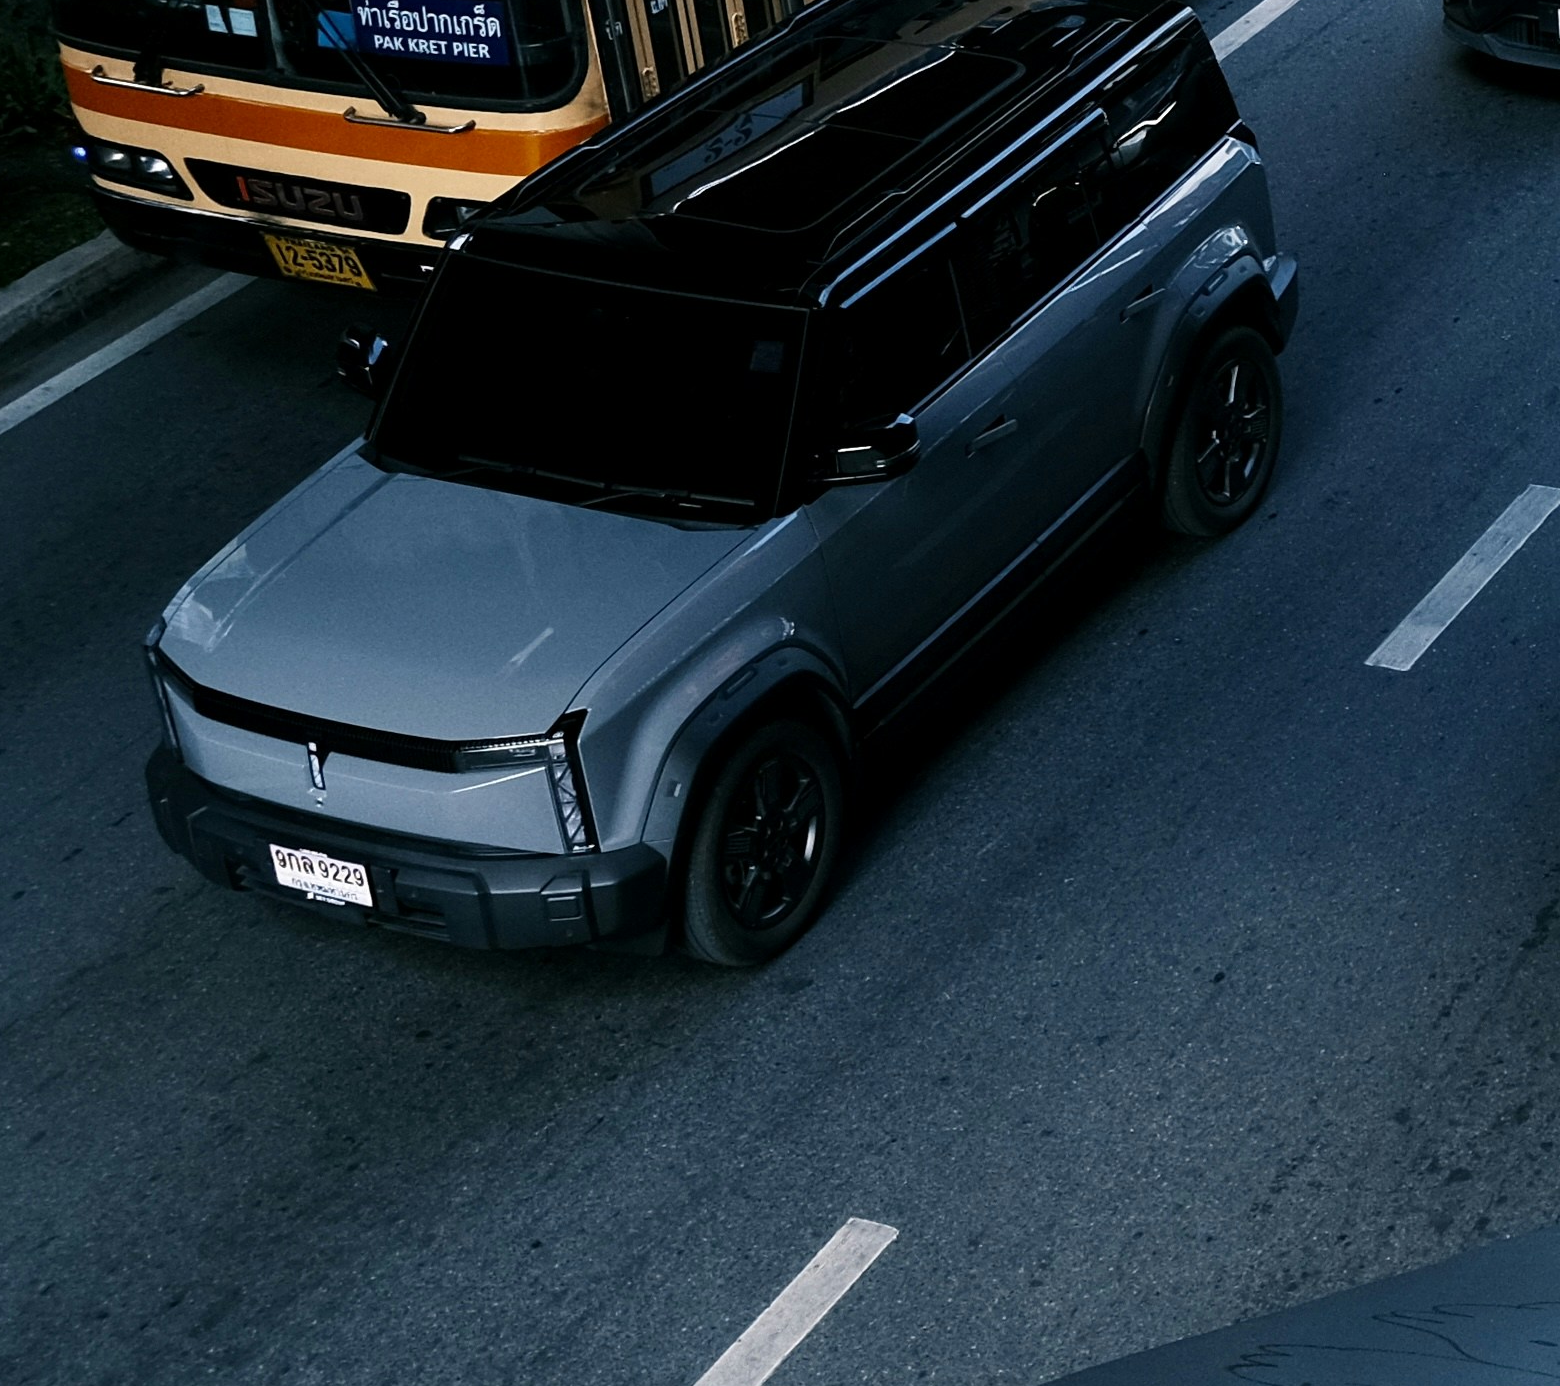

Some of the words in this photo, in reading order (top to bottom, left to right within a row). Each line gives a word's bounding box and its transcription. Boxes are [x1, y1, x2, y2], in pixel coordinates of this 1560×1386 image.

[373, 34, 405, 52] PAK
[408, 38, 448, 55] KRET
[453, 42, 491, 59] PIER
[236, 175, 364, 221] ISUZU
[276, 243, 363, 277] 12-5379
[318, 859, 365, 887] 9229
